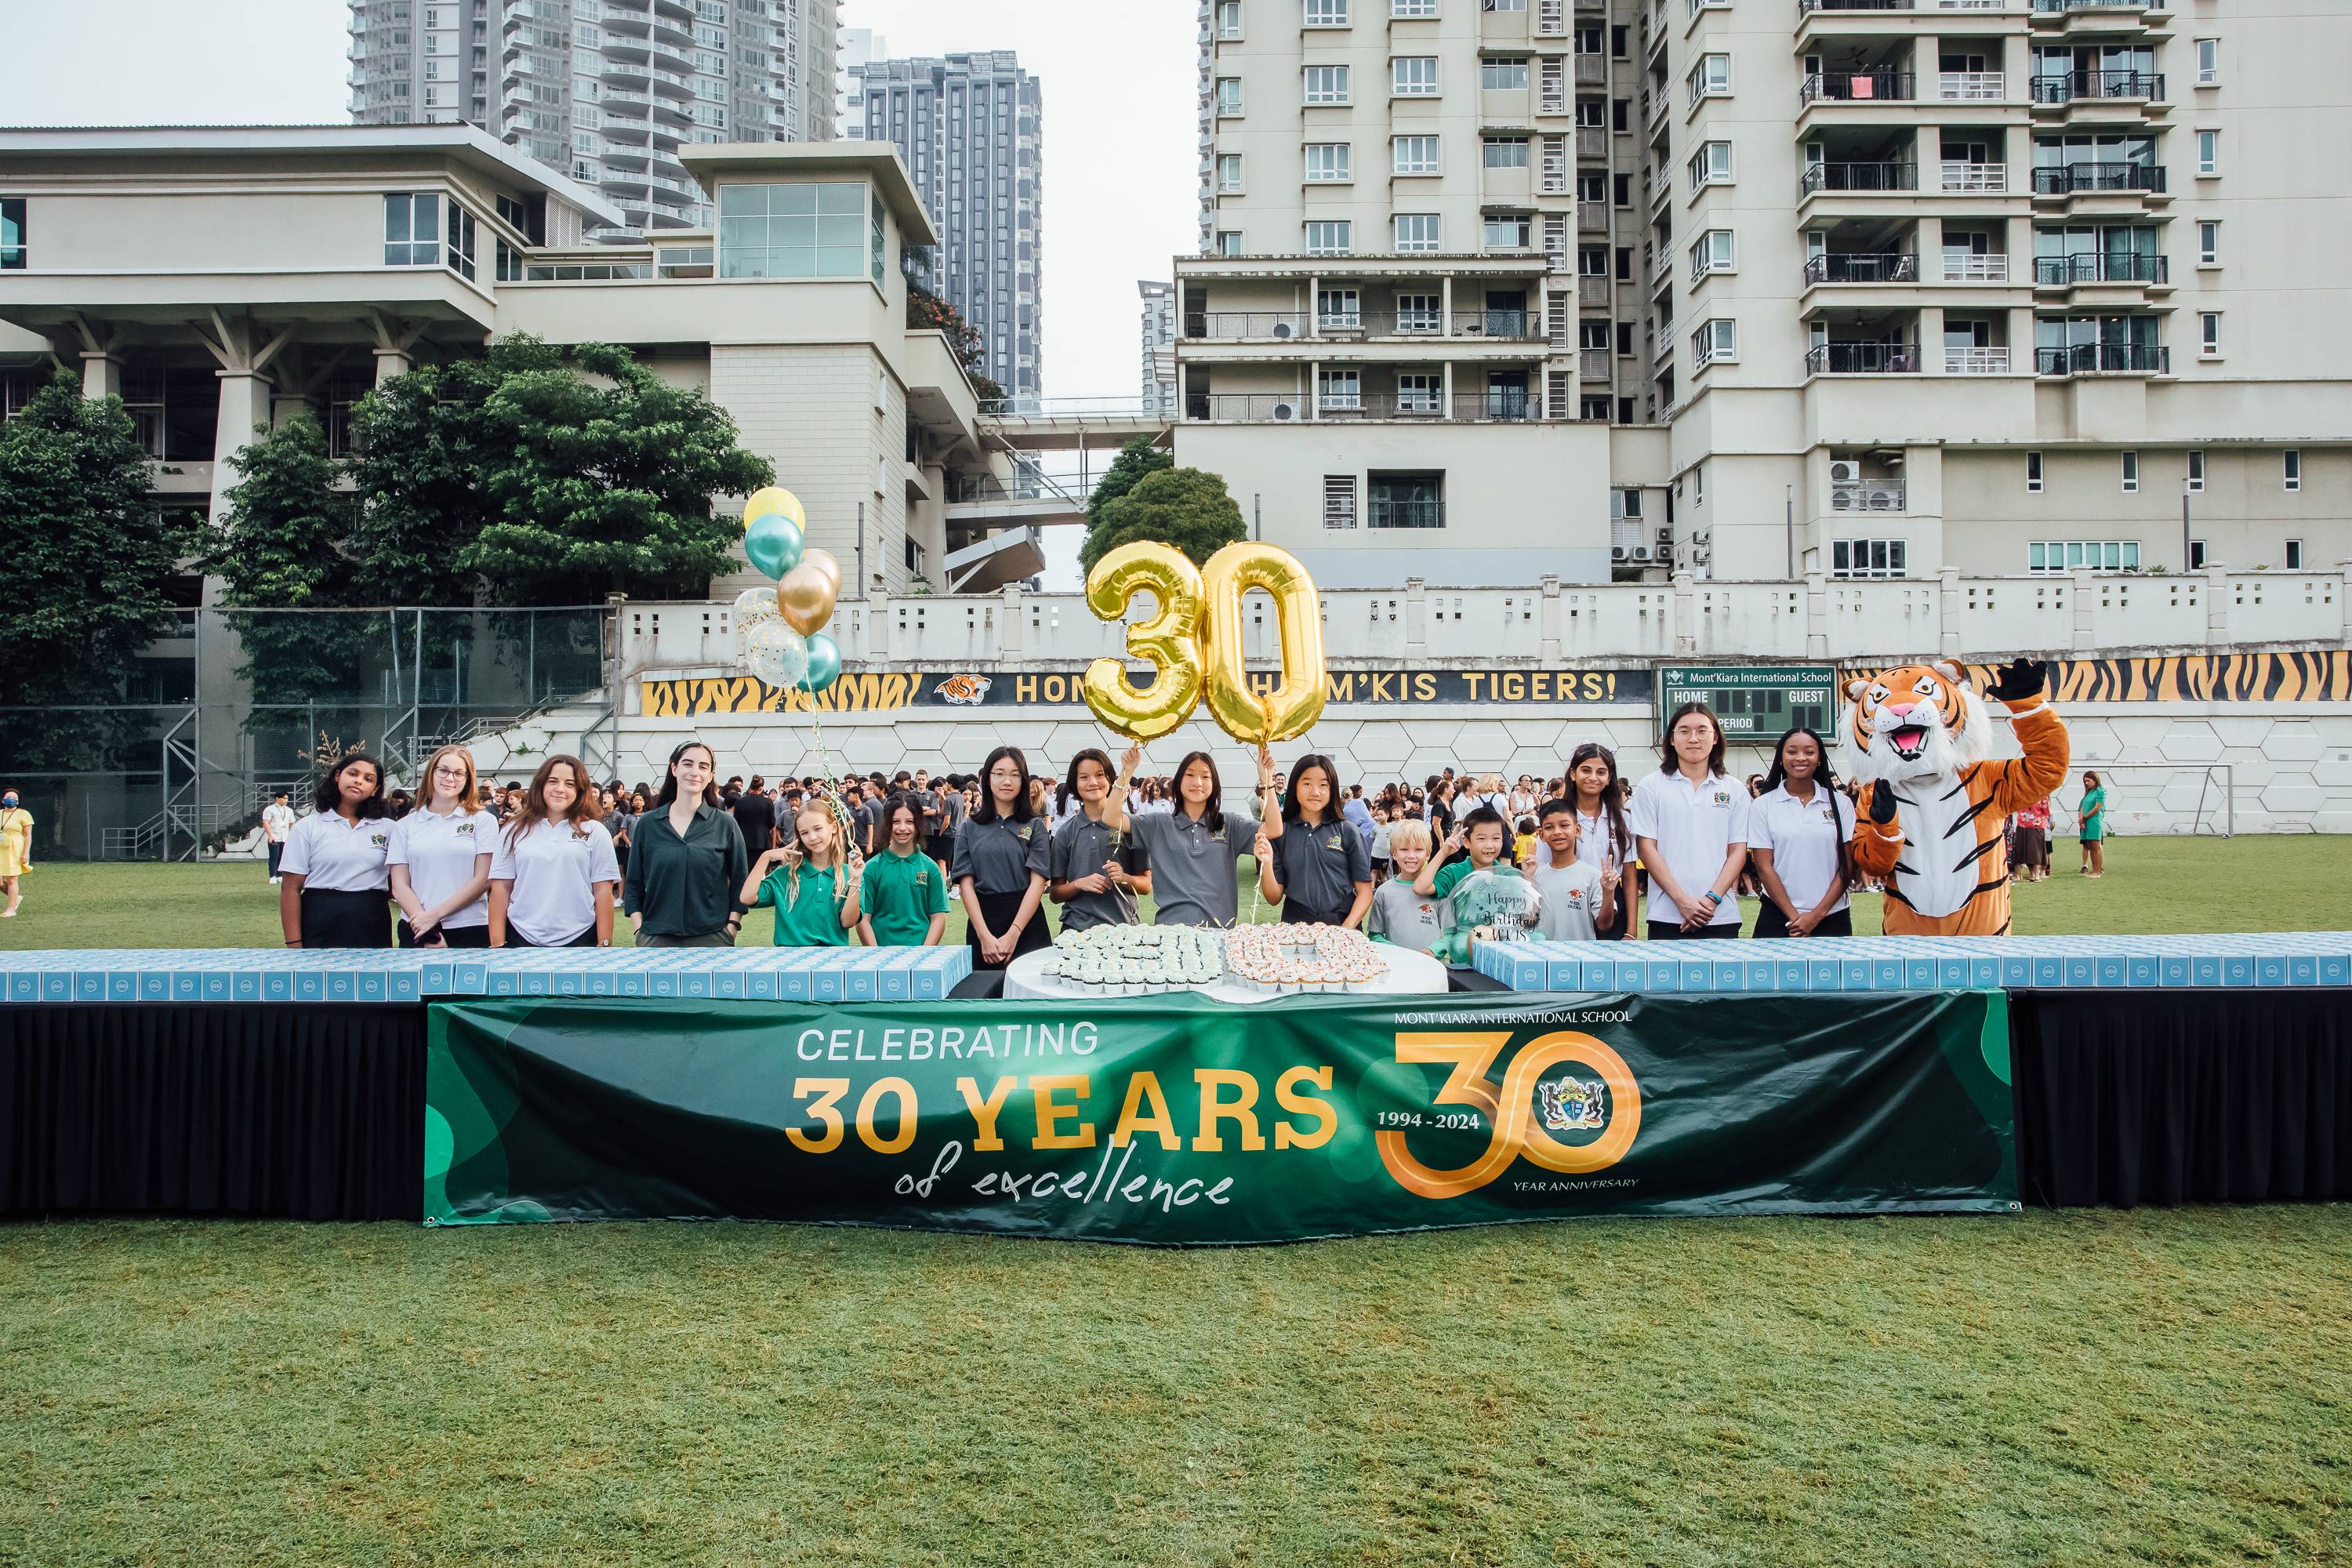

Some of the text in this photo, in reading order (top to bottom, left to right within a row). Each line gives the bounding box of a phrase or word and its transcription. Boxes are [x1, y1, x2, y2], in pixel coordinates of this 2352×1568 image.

[1461, 673, 1617, 701] TIGERS!
[1690, 672, 1831, 683] Mont'Kiara International School
[1674, 691, 1708, 703] HOME
[1788, 690, 1824, 703] GUEST
[1718, 717, 1753, 728] PERIOD
[1487, 891, 1527, 910] Happy
[1482, 910, 1536, 934] Birthday
[1394, 1010, 1633, 1025] MONT'KIARA INTERNATIONAL SCHOOL
[797, 1021, 1098, 1061] CELEBRATING
[785, 1065, 1339, 1154] 30 YEARS
[1377, 1111, 1422, 1127] 1994
[1435, 1113, 1480, 1130] 2024
[895, 1134, 1235, 1212] of excellence
[1513, 1178, 1640, 1192] YEAR ANNIVERSARY
